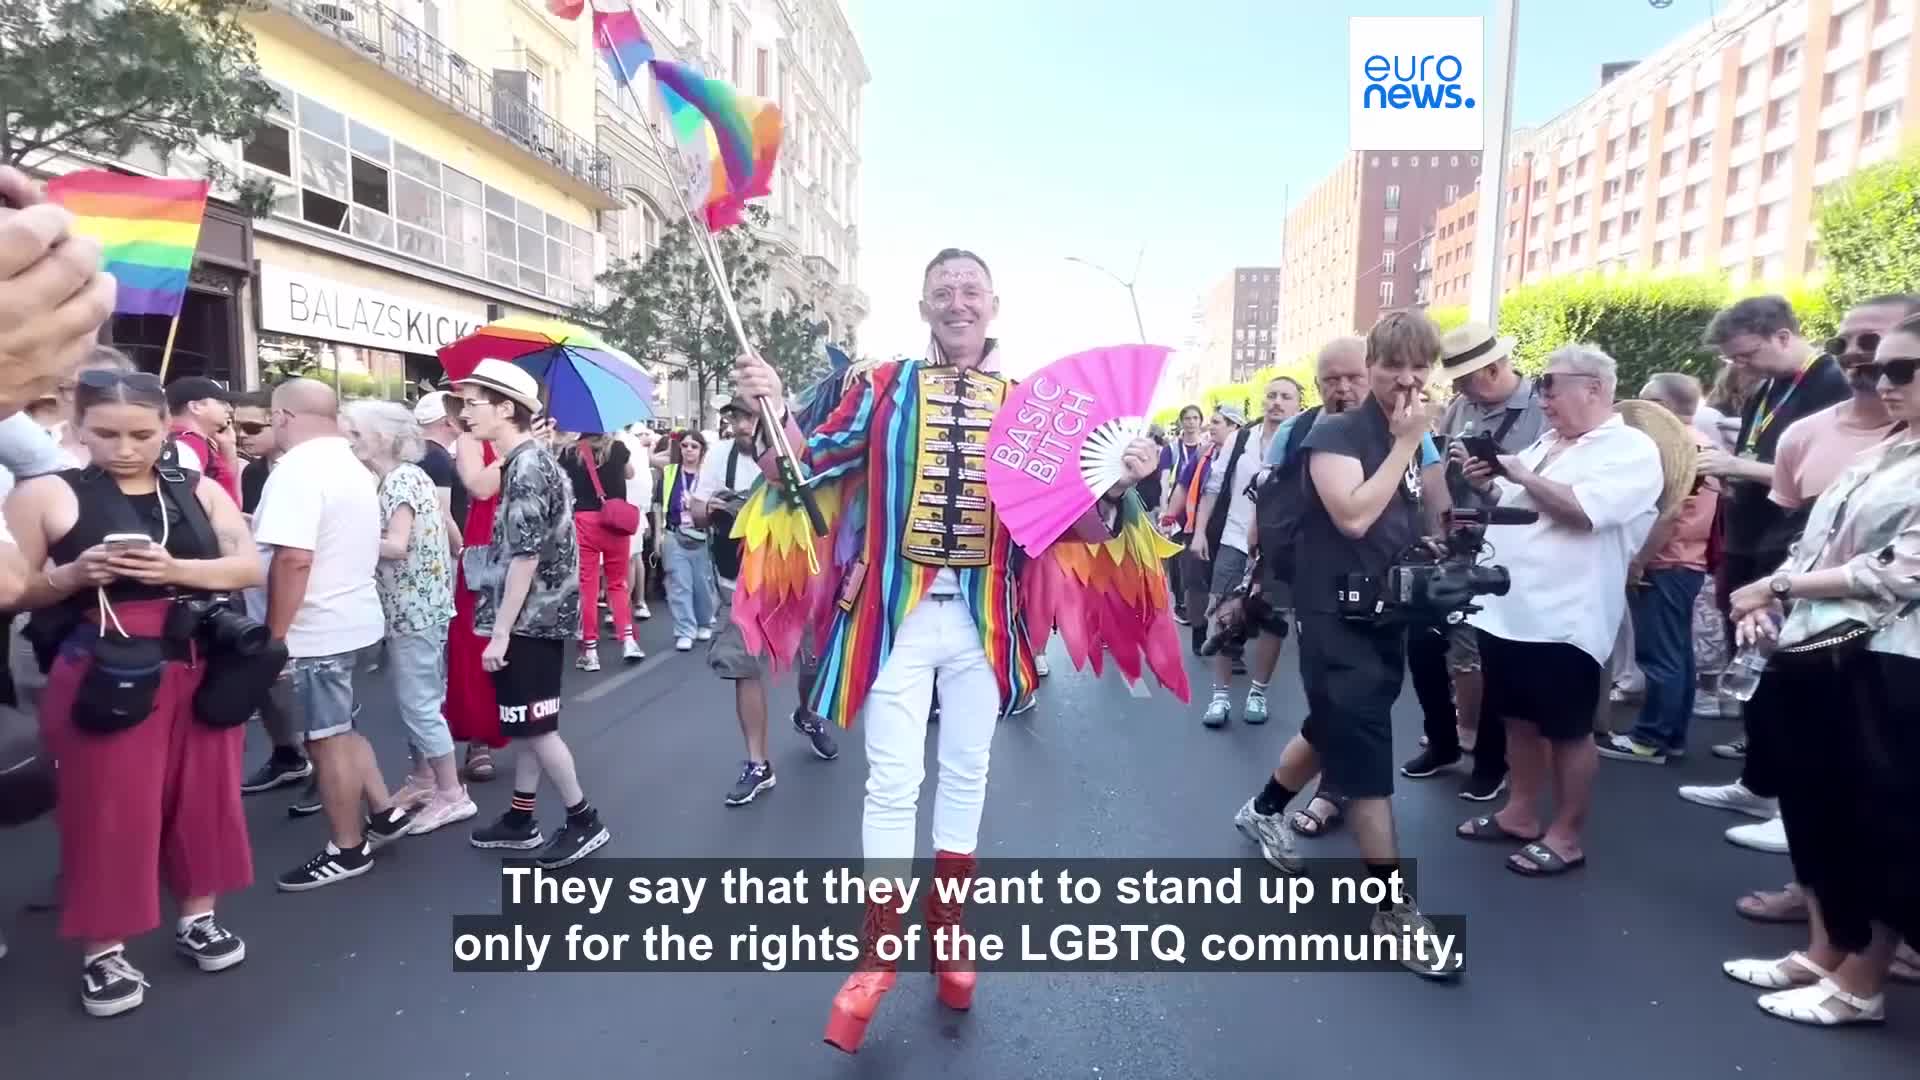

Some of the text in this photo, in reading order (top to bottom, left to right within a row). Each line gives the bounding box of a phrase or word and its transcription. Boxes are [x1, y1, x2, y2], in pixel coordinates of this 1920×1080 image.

[289, 281, 482, 346] BALAZSKICK
[991, 377, 1062, 470] BASIC
[1023, 389, 1095, 485] BITCH
[499, 704, 528, 723] UST
